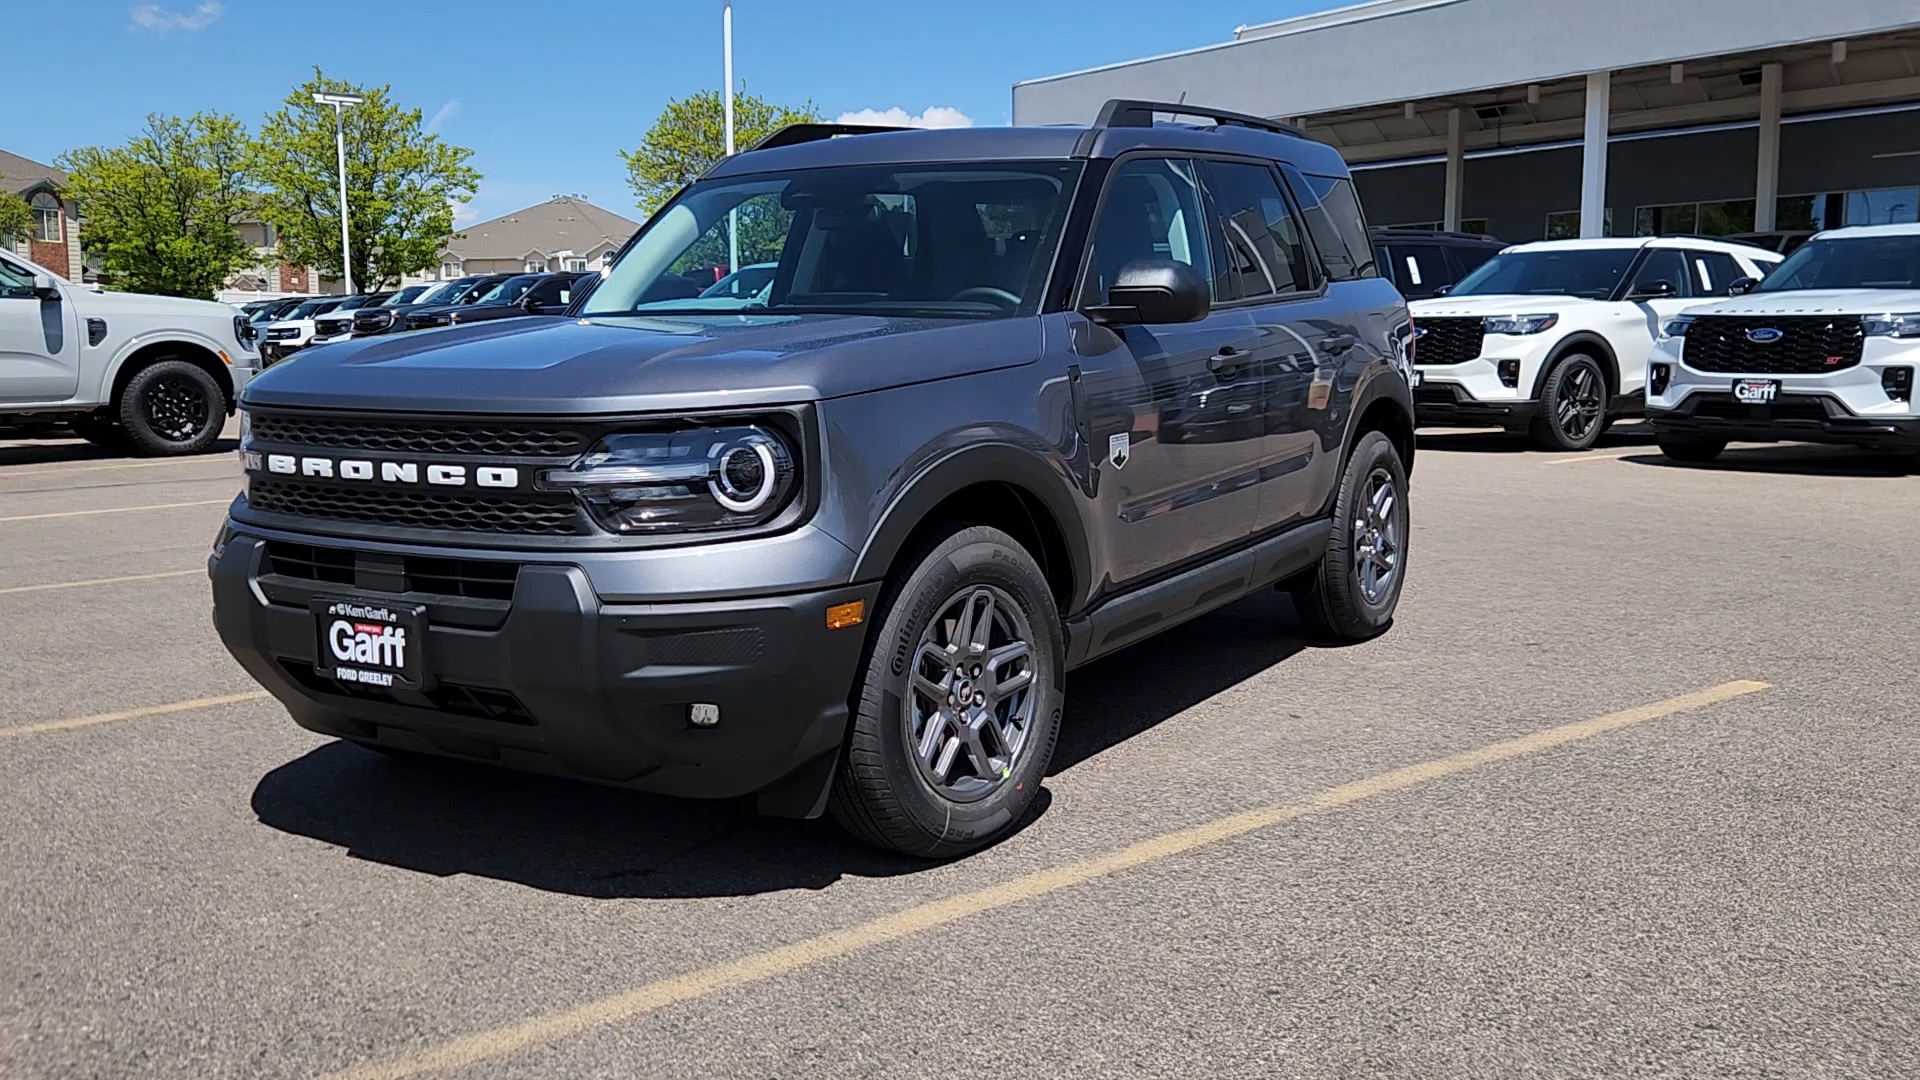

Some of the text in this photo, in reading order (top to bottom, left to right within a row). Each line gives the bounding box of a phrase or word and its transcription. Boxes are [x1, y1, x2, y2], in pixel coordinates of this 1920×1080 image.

[1735, 383, 1776, 400] Garff
[267, 453, 519, 489] BRONCO
[345, 603, 389, 622] Ken Garff
[329, 619, 406, 668] Garff
[336, 667, 394, 686] FORD GREELEY
